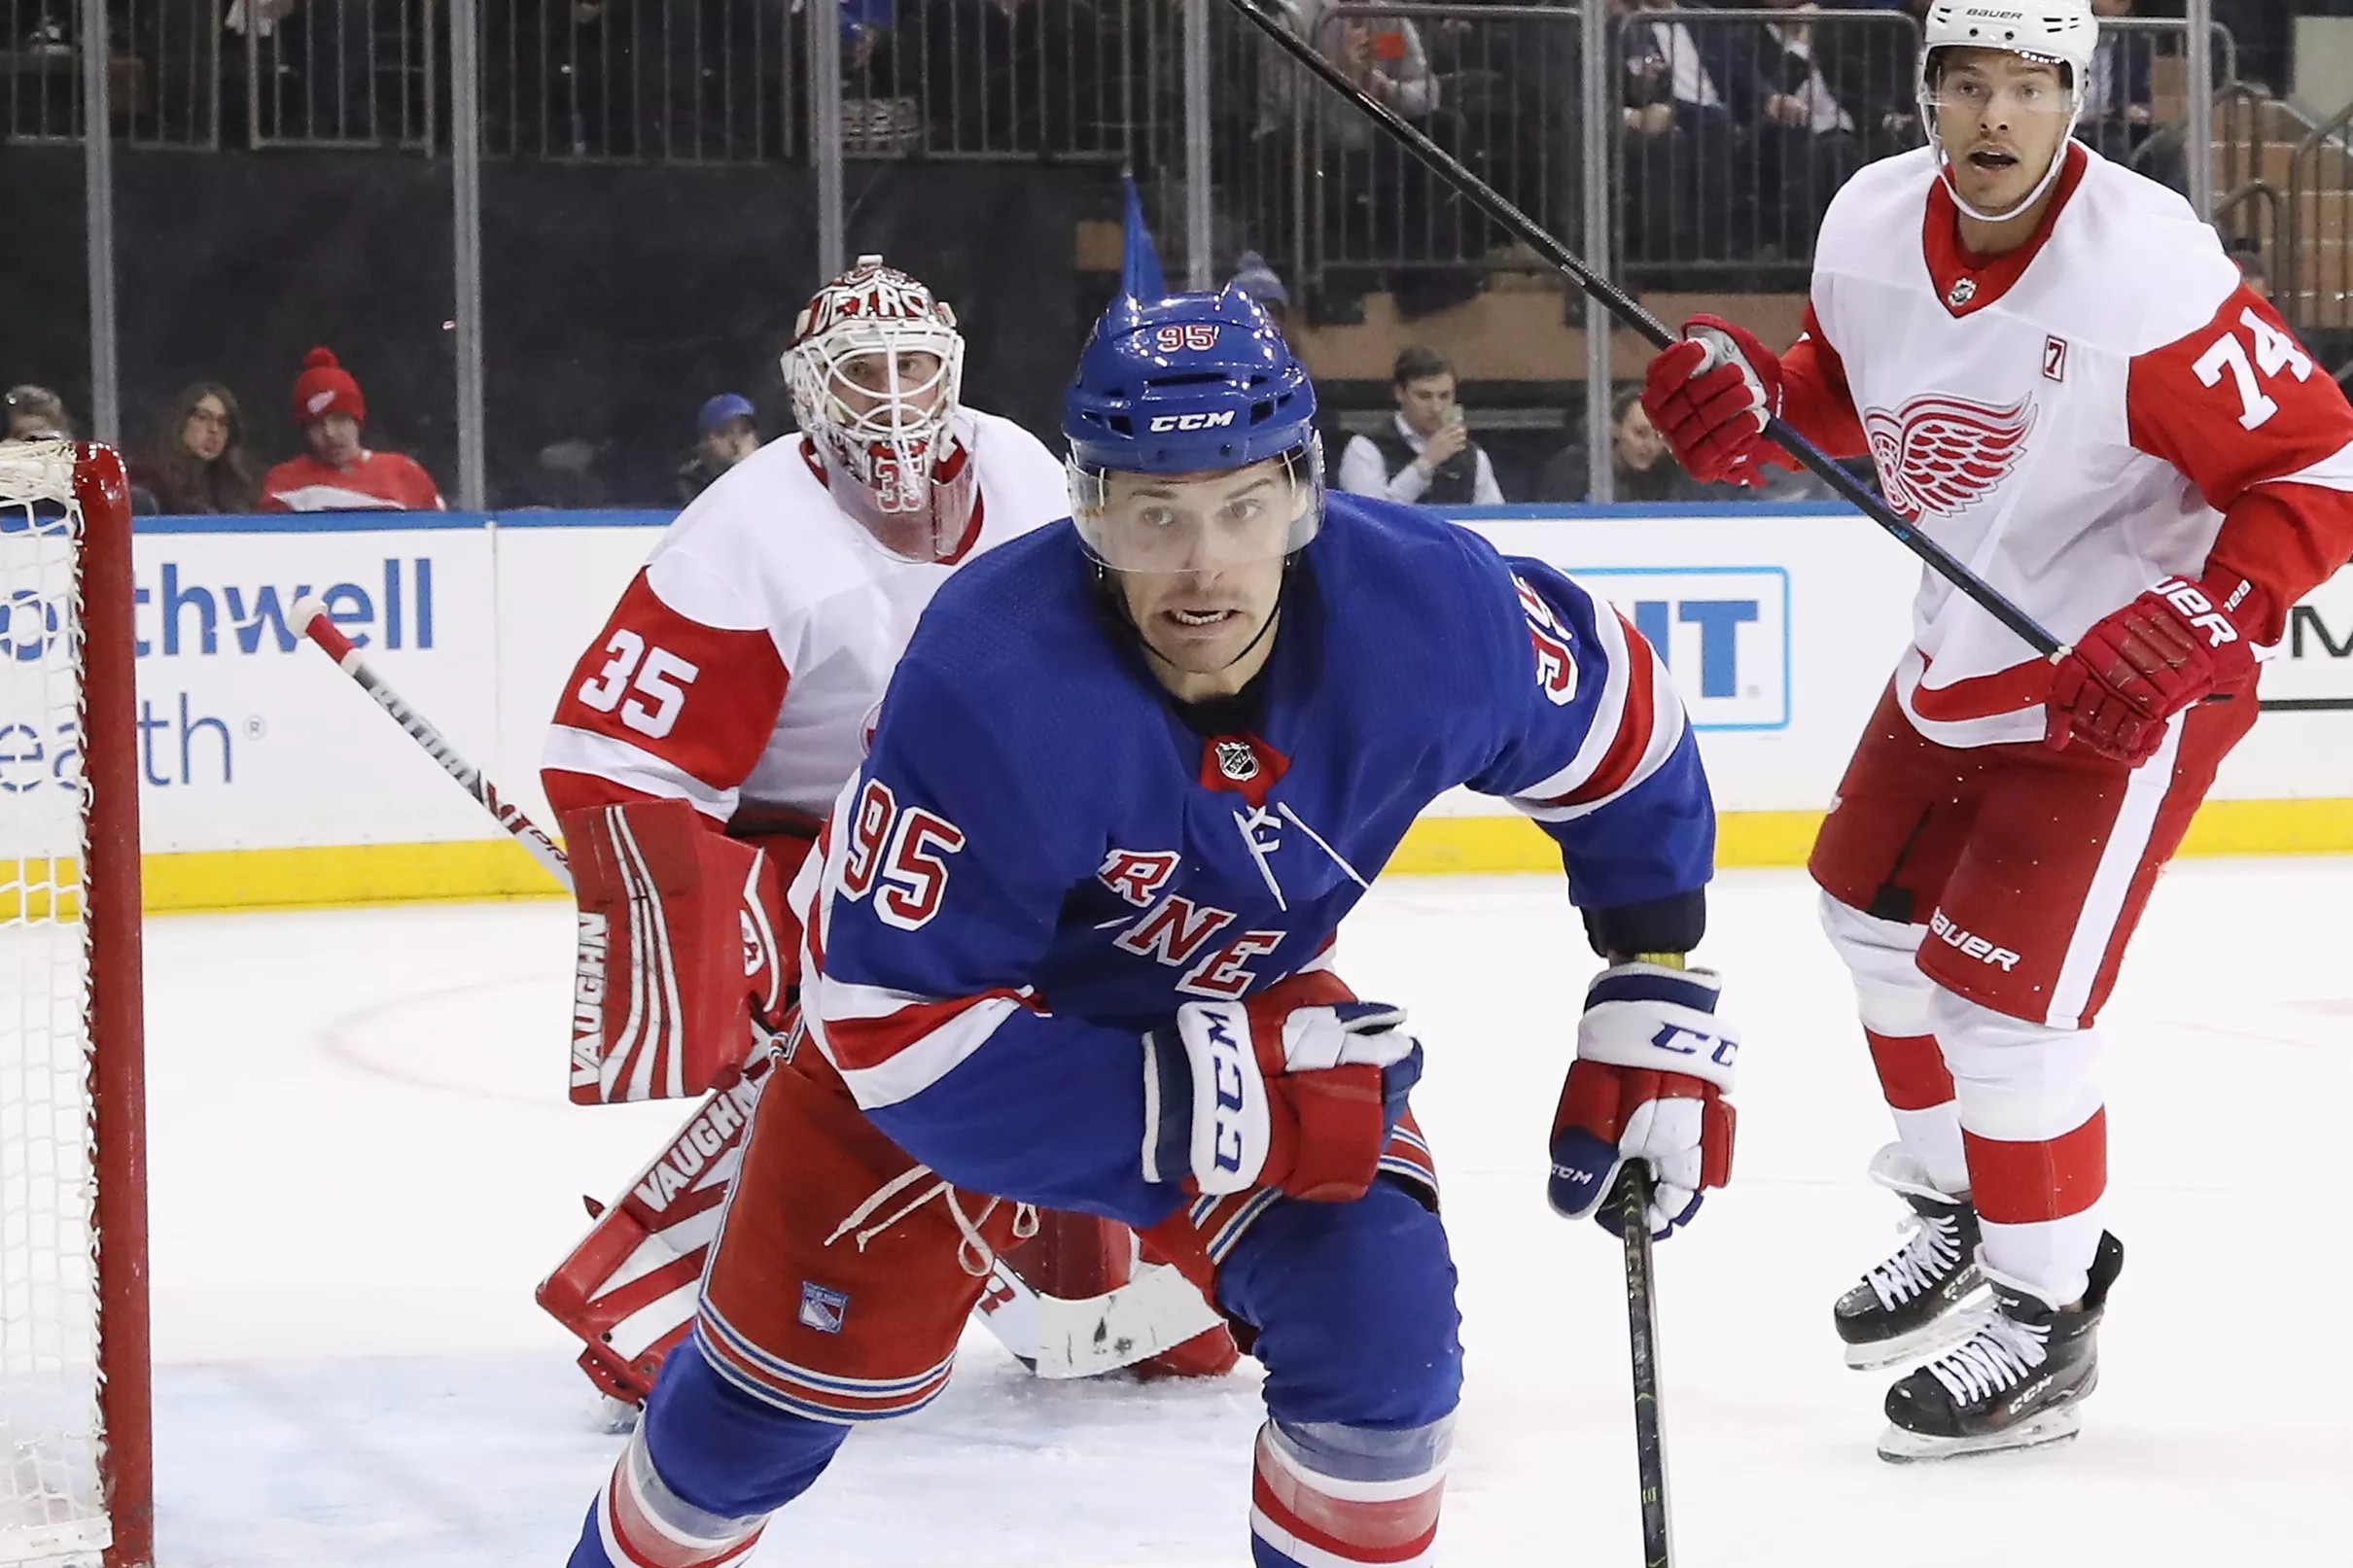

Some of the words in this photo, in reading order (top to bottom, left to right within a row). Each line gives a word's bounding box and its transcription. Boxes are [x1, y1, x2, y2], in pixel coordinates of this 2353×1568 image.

[813, 281, 929, 335] DETRO
[1155, 325, 1215, 352] 95
[2046, 340, 2063, 375] 7
[2192, 305, 2313, 432] 74
[1149, 409, 1236, 434] CCM
[2150, 574, 2239, 649] UER
[578, 627, 700, 740] 35
[834, 776, 967, 932] 95
[1929, 906, 2021, 973] AUER
[571, 911, 608, 1088] VAUGHN
[1649, 1021, 1739, 1067] CC
[1199, 1009, 1245, 1173] CCM
